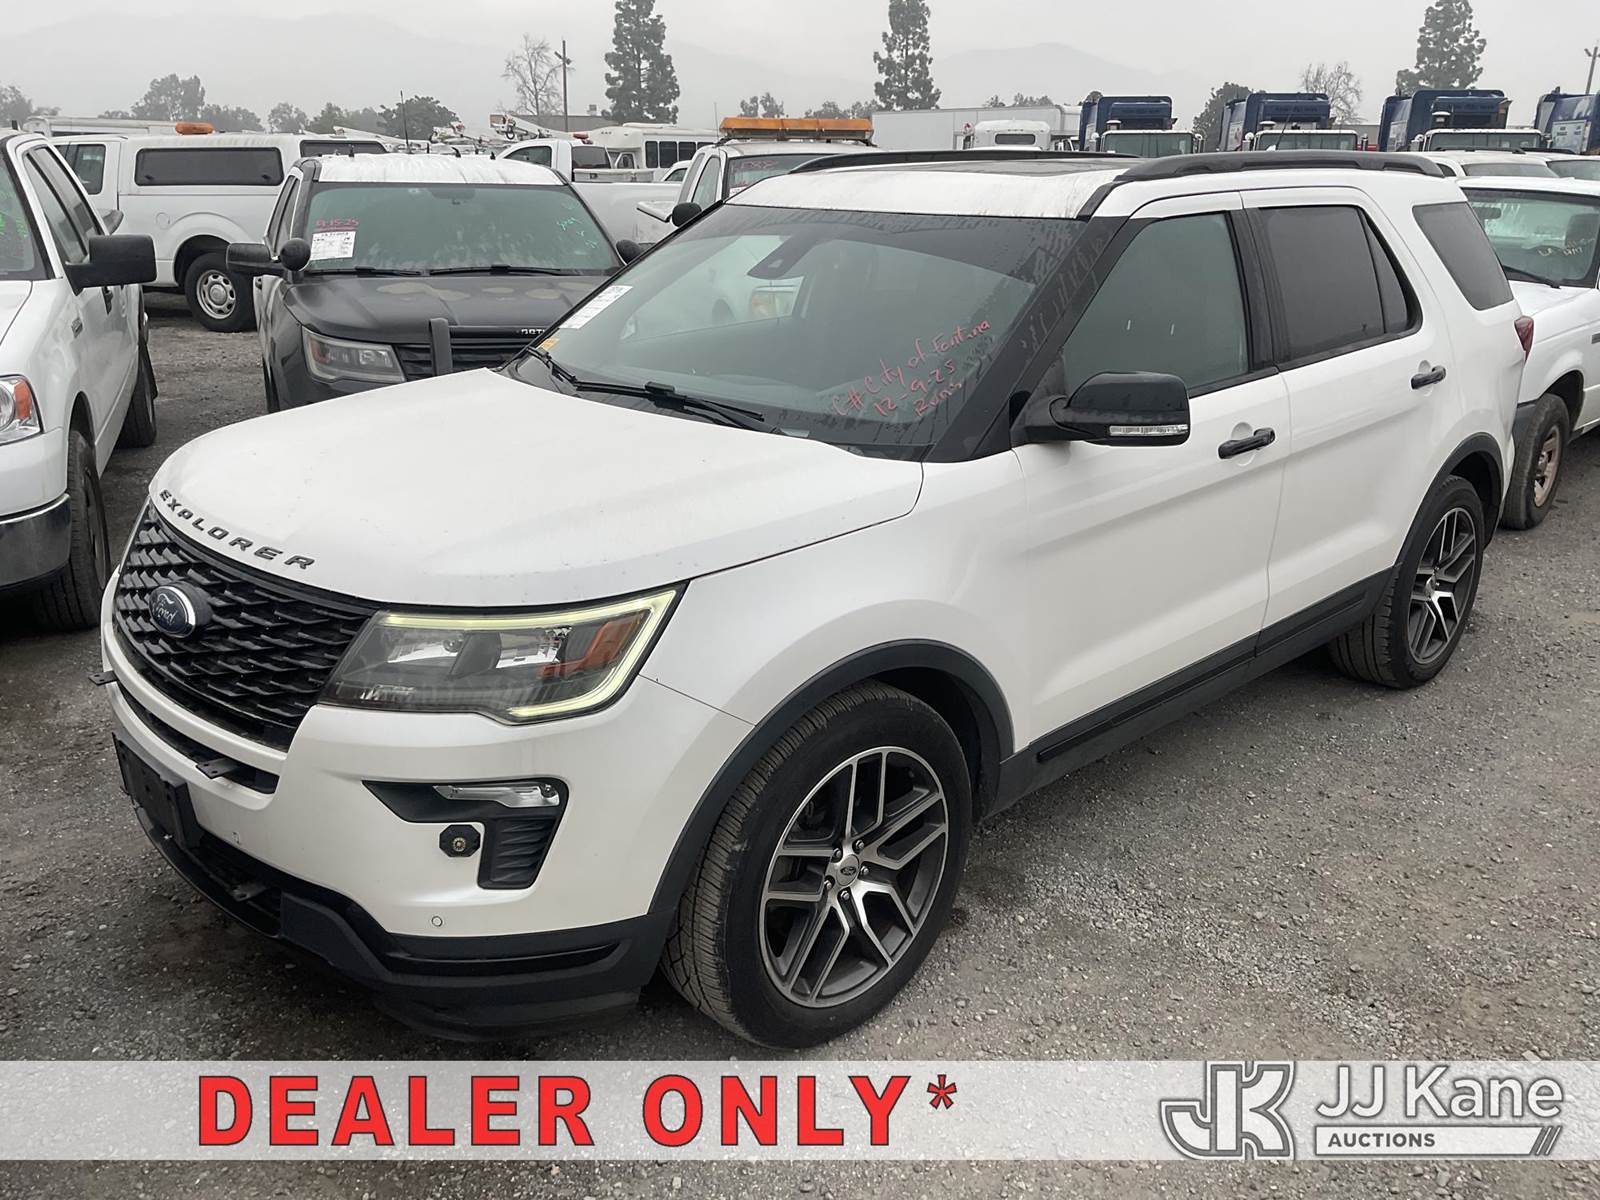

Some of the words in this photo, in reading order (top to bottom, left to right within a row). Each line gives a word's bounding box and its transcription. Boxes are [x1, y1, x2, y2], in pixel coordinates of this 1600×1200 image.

[864, 358, 906, 394] City
[907, 338, 927, 370] of
[159, 489, 315, 570] EXPLORER
